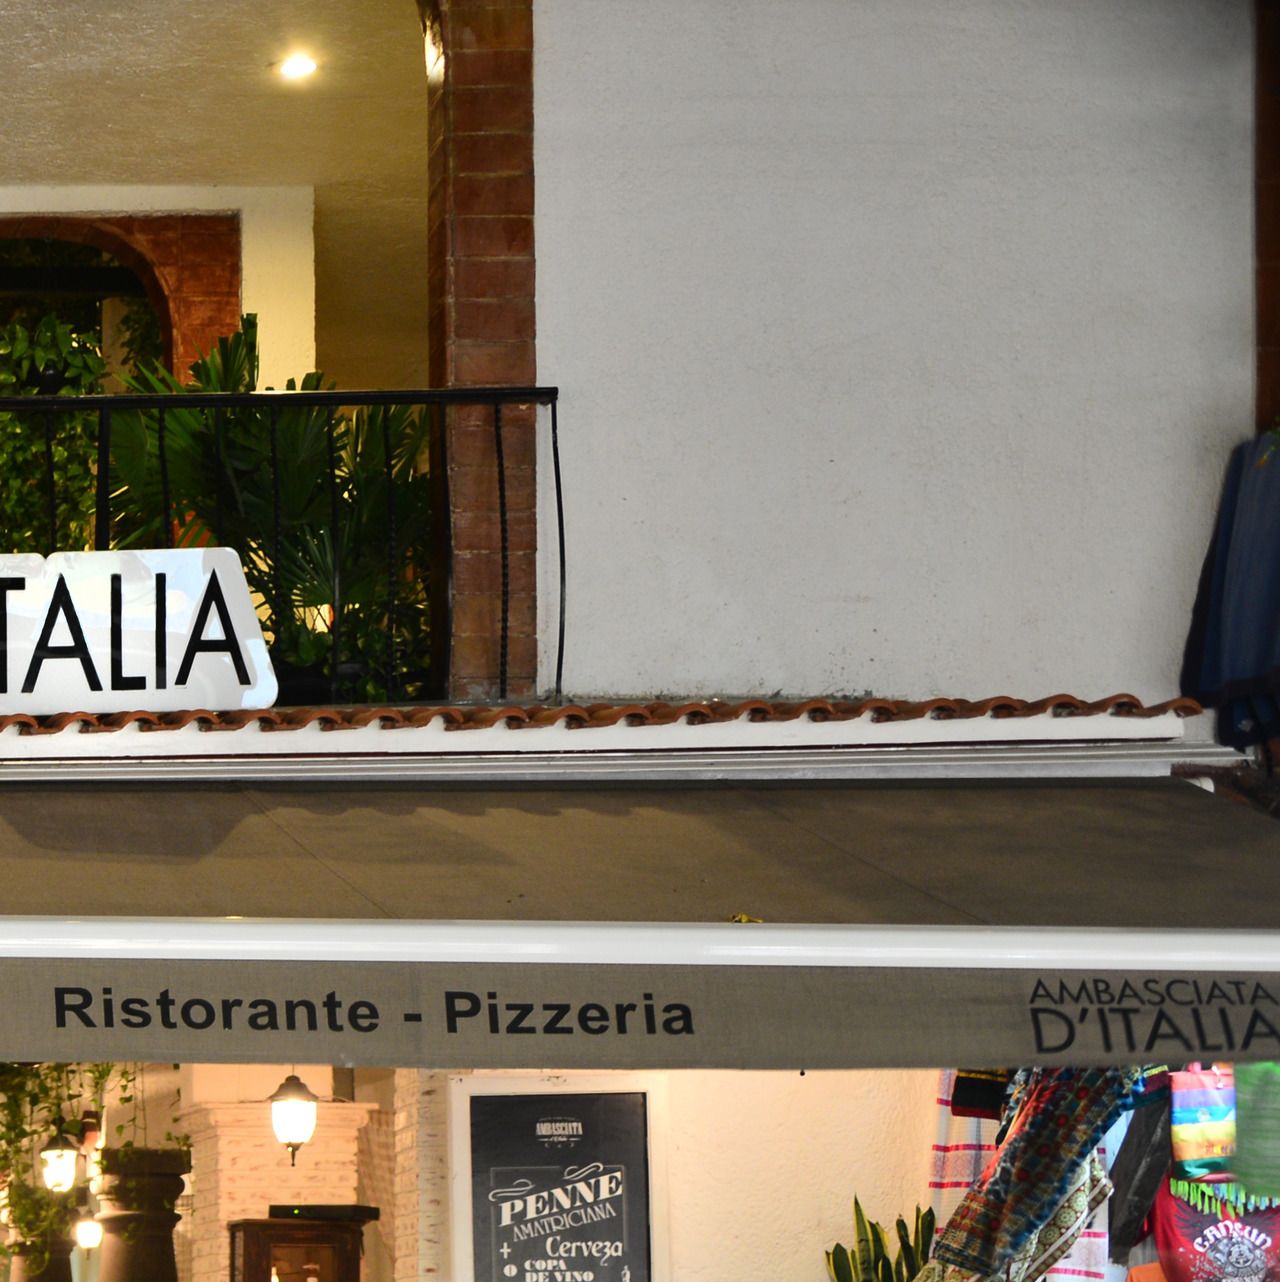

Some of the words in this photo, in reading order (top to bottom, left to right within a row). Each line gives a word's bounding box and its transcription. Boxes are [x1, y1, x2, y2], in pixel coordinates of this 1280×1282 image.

[1029, 978, 1280, 1006] AMBASCIATA
[53, 986, 380, 1032] Ristorante
[443, 990, 695, 1036] Pizzeria
[1030, 1007, 1280, 1053] D'ITALIA
[498, 1171, 623, 1227] PENNE
[512, 1201, 617, 1242] AMATRICIANA
[524, 1259, 567, 1271] COPA
[545, 1235, 623, 1267] Cerveza
[524, 1271, 549, 1282] DE
[554, 1271, 595, 1282] VINO
